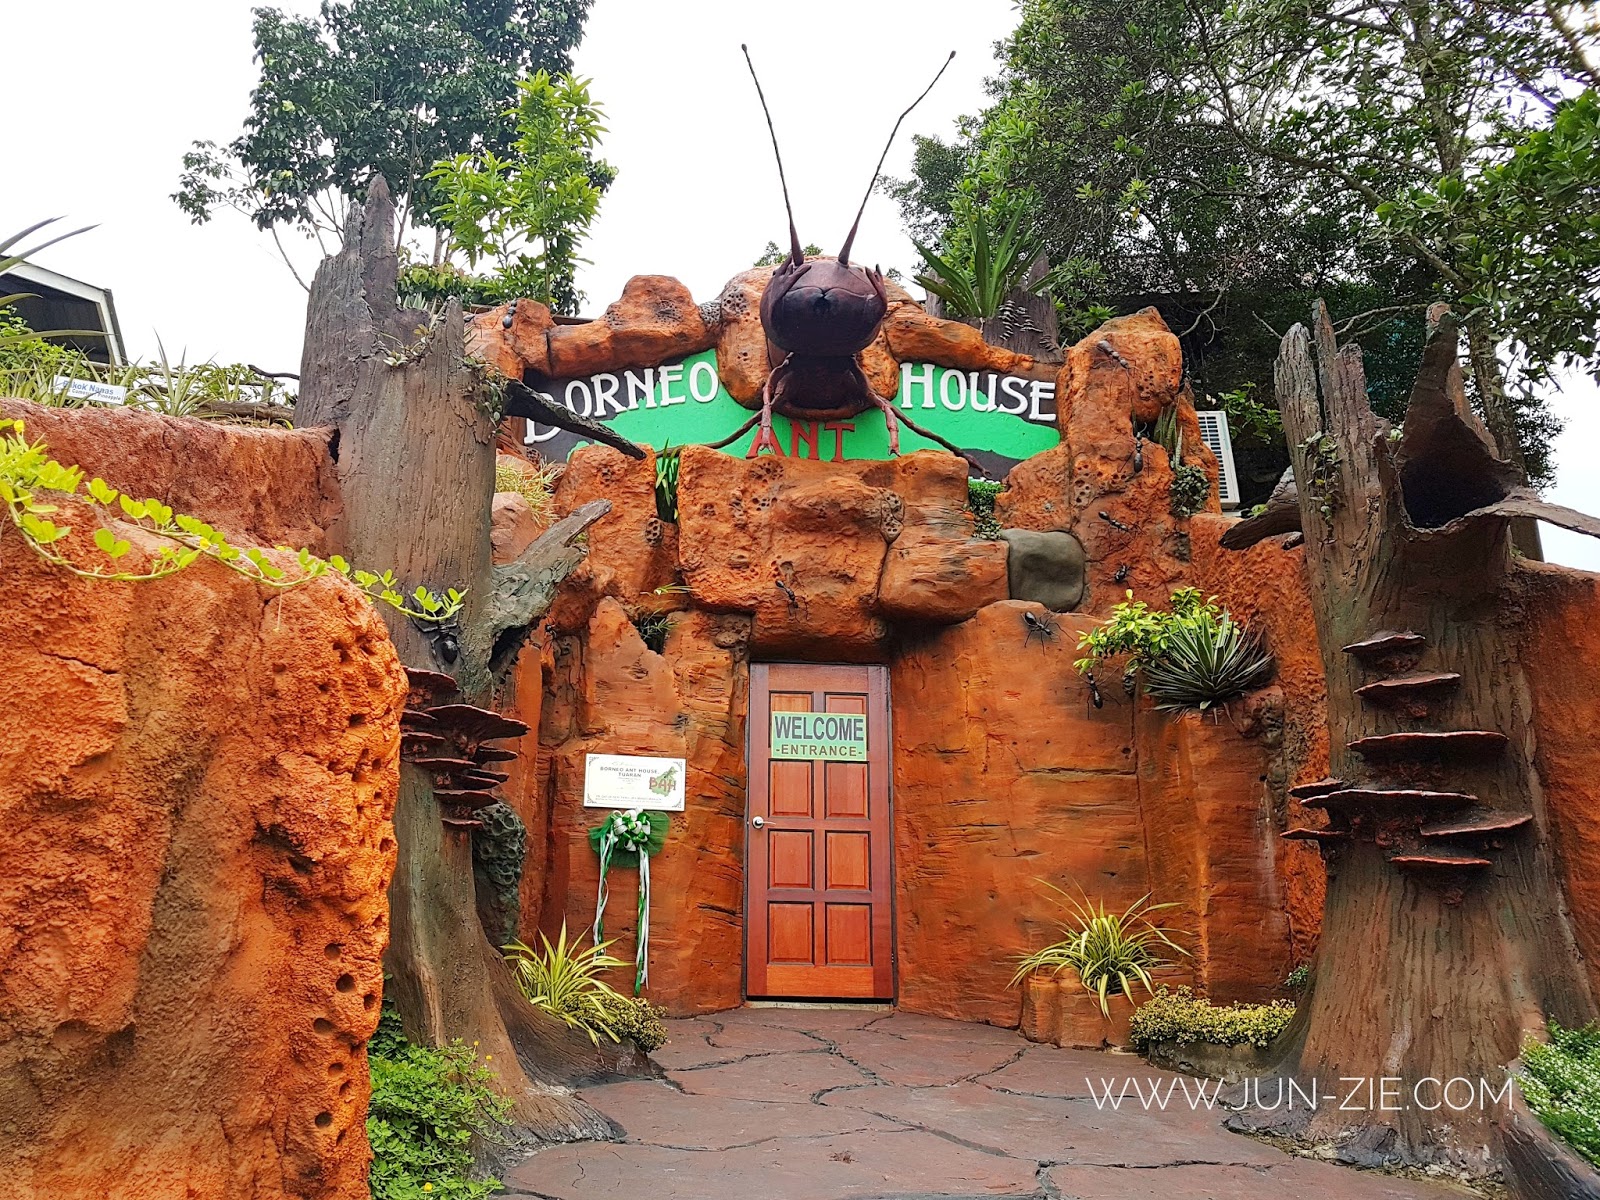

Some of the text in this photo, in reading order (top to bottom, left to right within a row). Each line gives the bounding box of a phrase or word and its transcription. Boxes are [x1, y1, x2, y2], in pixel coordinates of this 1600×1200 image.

[746, 420, 855, 462] ANT
[900, 362, 1057, 421] HOUSE
[775, 716, 864, 741] WELCOME
[648, 776, 677, 792] BAH
